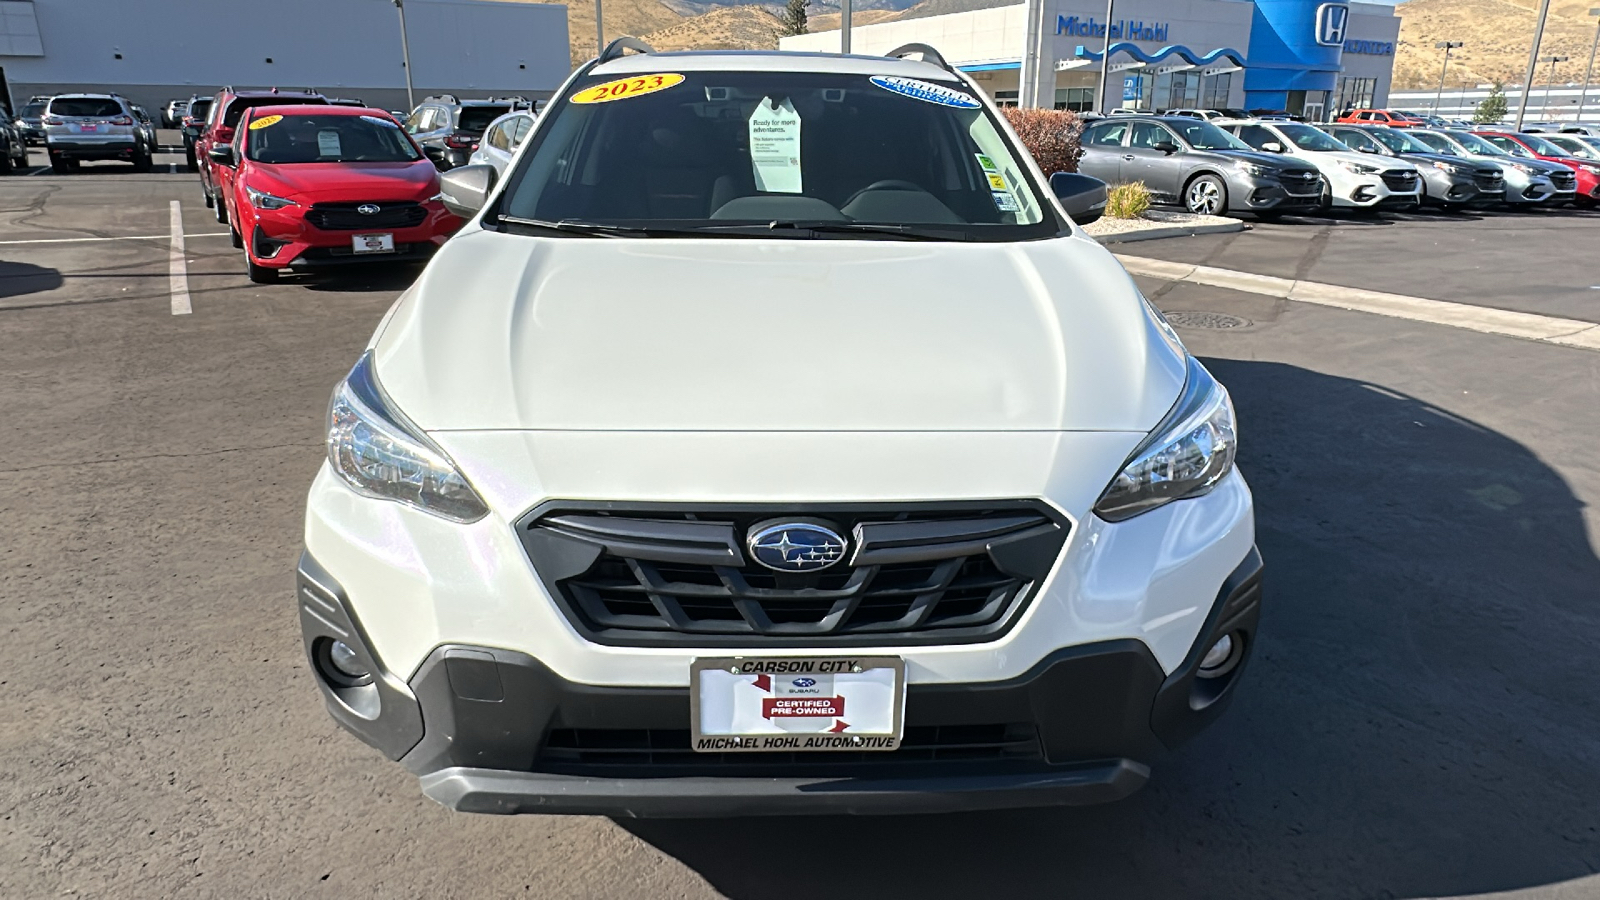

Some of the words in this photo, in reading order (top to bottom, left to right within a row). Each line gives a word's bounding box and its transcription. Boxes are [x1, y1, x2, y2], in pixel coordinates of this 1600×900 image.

[1057, 14, 1124, 39] Michael
[1129, 20, 1168, 41] Hohl
[592, 76, 664, 101] 2023
[753, 119, 771, 127] Ready
[741, 660, 814, 673] CARSON
[818, 660, 858, 672] CITY
[770, 706, 836, 715] PRE-OWNED
[776, 700, 831, 708] CERTIFIED
[697, 737, 760, 749] MICHAEL
[763, 737, 801, 748] HOHL
[804, 736, 896, 748] AUTOMOTIVE
